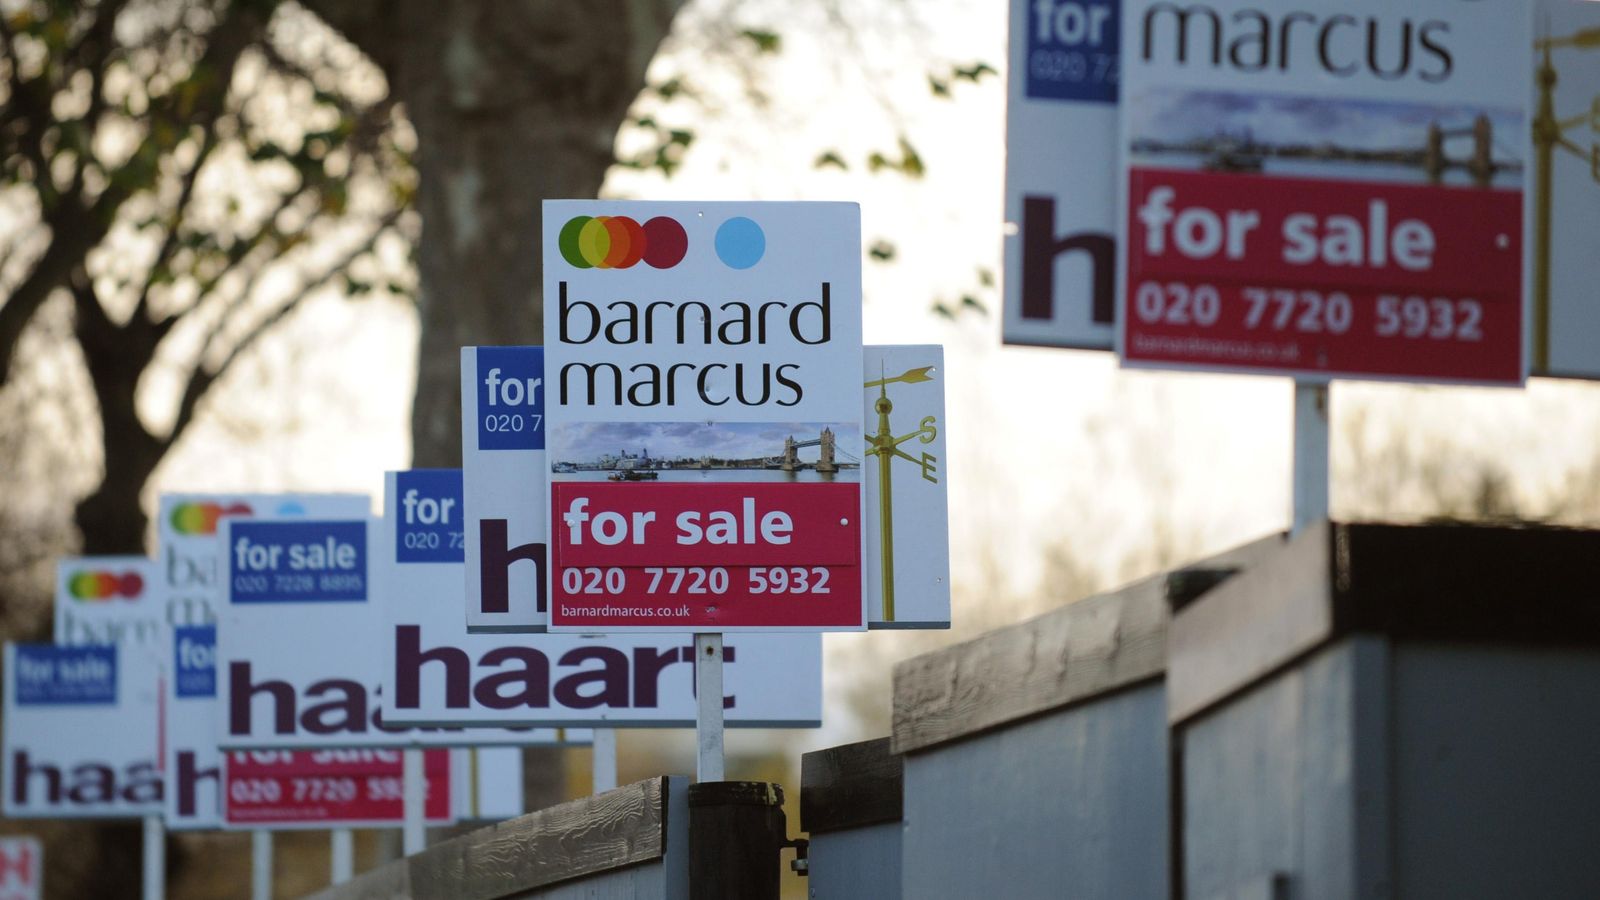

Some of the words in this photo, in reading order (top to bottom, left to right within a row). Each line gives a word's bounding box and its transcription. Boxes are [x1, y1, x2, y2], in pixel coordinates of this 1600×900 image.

[1141, 2, 1454, 84] marcus
[1138, 186, 1260, 260] for
[1282, 199, 1436, 271] sale
[559, 281, 832, 345] barnard
[1136, 281, 1222, 327] 020
[1242, 286, 1353, 334] 7720
[1375, 294, 1484, 342] 5932
[485, 368, 542, 406] for
[559, 361, 804, 408] marcus
[485, 414, 524, 432] 020
[402, 489, 455, 525] for
[563, 497, 656, 546] for
[675, 497, 794, 546] sale
[235, 537, 282, 571] for
[288, 535, 356, 570] sale
[404, 532, 440, 549] 020
[562, 567, 626, 595] 020
[644, 567, 729, 594] 7720
[748, 567, 831, 594] 5932
[561, 604, 690, 617] barnardmarcus.co.uk
